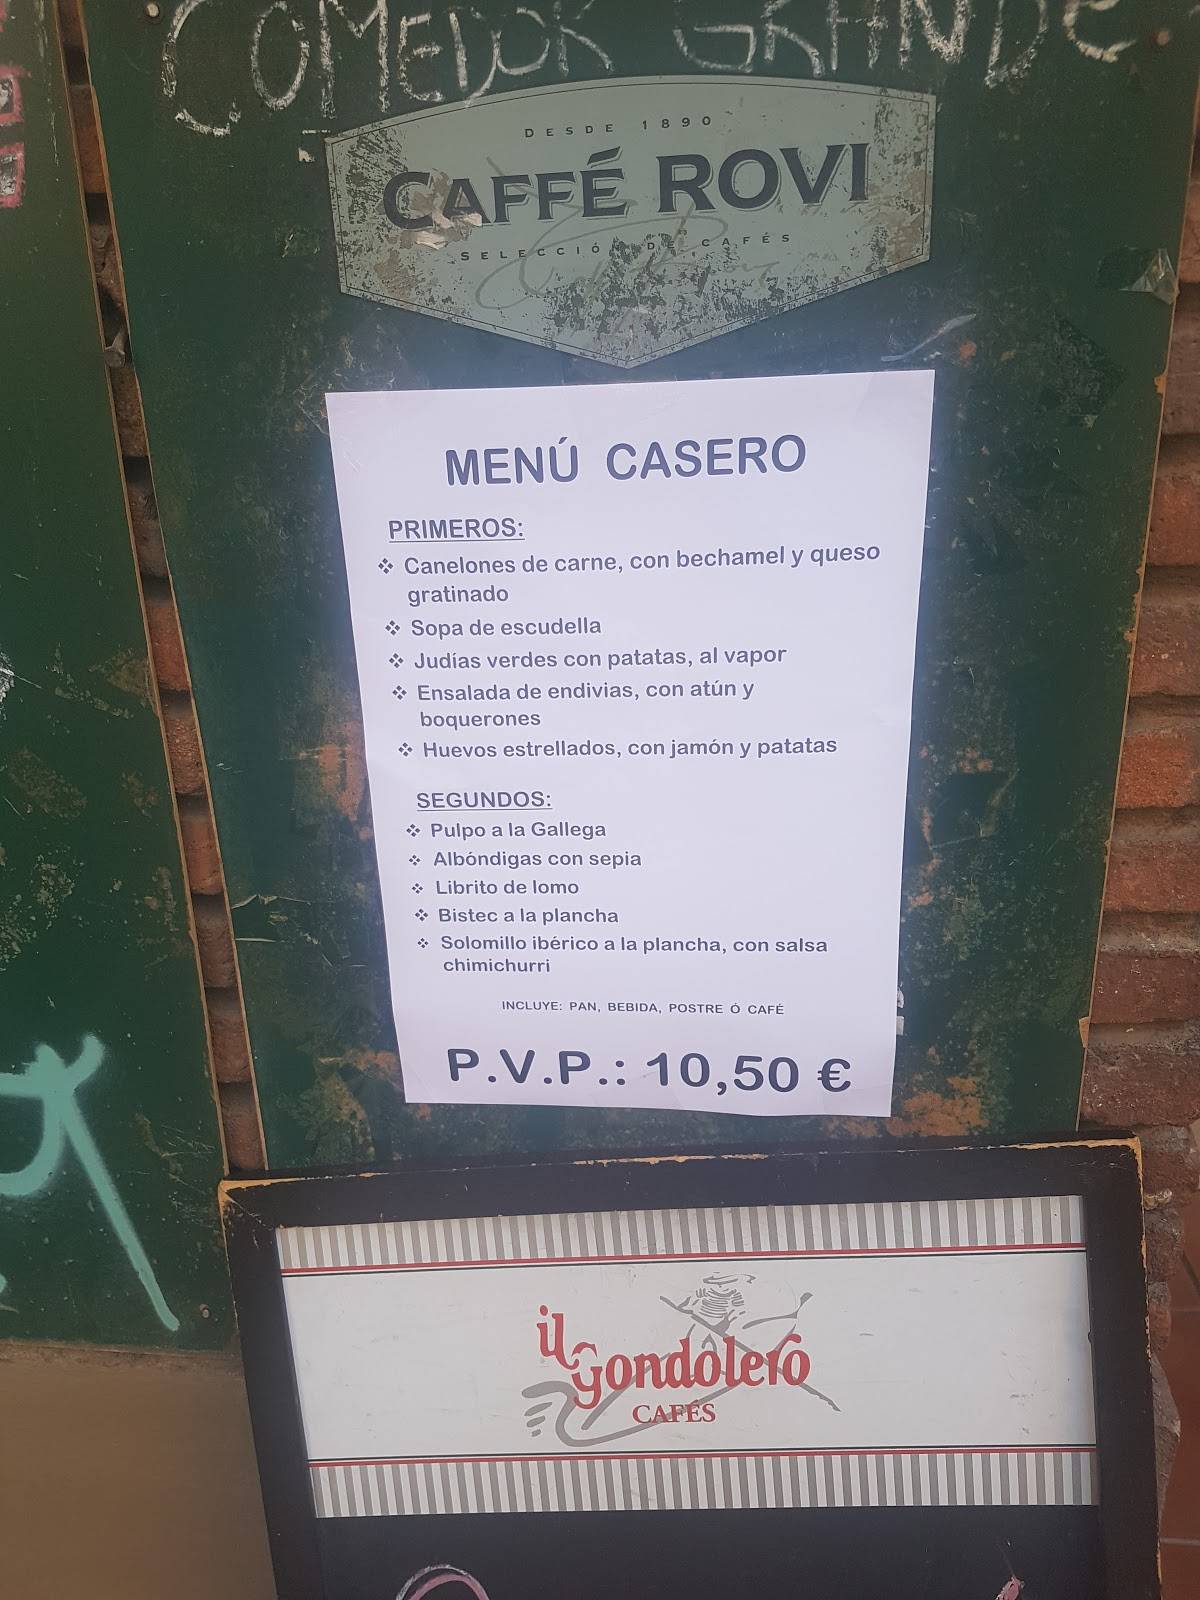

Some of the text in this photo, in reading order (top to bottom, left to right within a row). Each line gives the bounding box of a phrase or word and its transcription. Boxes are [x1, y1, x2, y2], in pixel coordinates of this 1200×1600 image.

[524, 115, 713, 138] DESDE 1890
[382, 142, 870, 231] CAFFÉ ROVI
[460, 232, 790, 262] SELECCIÓ DE CAFÉS
[445, 434, 806, 487] MENÚ CASERO
[388, 517, 526, 544] PRIMEROS:
[404, 545, 881, 575] Canelones de carne, con bechamel y queso
[407, 584, 509, 608] gratinado
[411, 616, 602, 641] Sopa de escudella
[413, 646, 788, 671] Judías verdes con patatas, al vapor
[417, 679, 755, 701] Ensalada de endivias, con atún y
[419, 711, 541, 732] boquerones
[423, 737, 838, 760] Huevos estrellados, con jamón y patatas
[416, 790, 554, 812] SEGUNDOS:
[430, 821, 607, 842] Pulpo a la Gallega
[433, 850, 642, 870] Albóndigas con sepia
[435, 879, 580, 895] Librito de lomo
[438, 907, 619, 926] Bistec a la plancha
[440, 935, 828, 955] Solomillo ibérico a la plancha, con salsa
[443, 957, 551, 973] chimichurri
[500, 1000, 785, 1015] INCLUYE: PAN, BEBIDA, POSTRE Ó CAFÉ
[447, 1048, 852, 1096] P.V.P.: 10,50 €
[632, 1399, 716, 1425] CAFÉS
